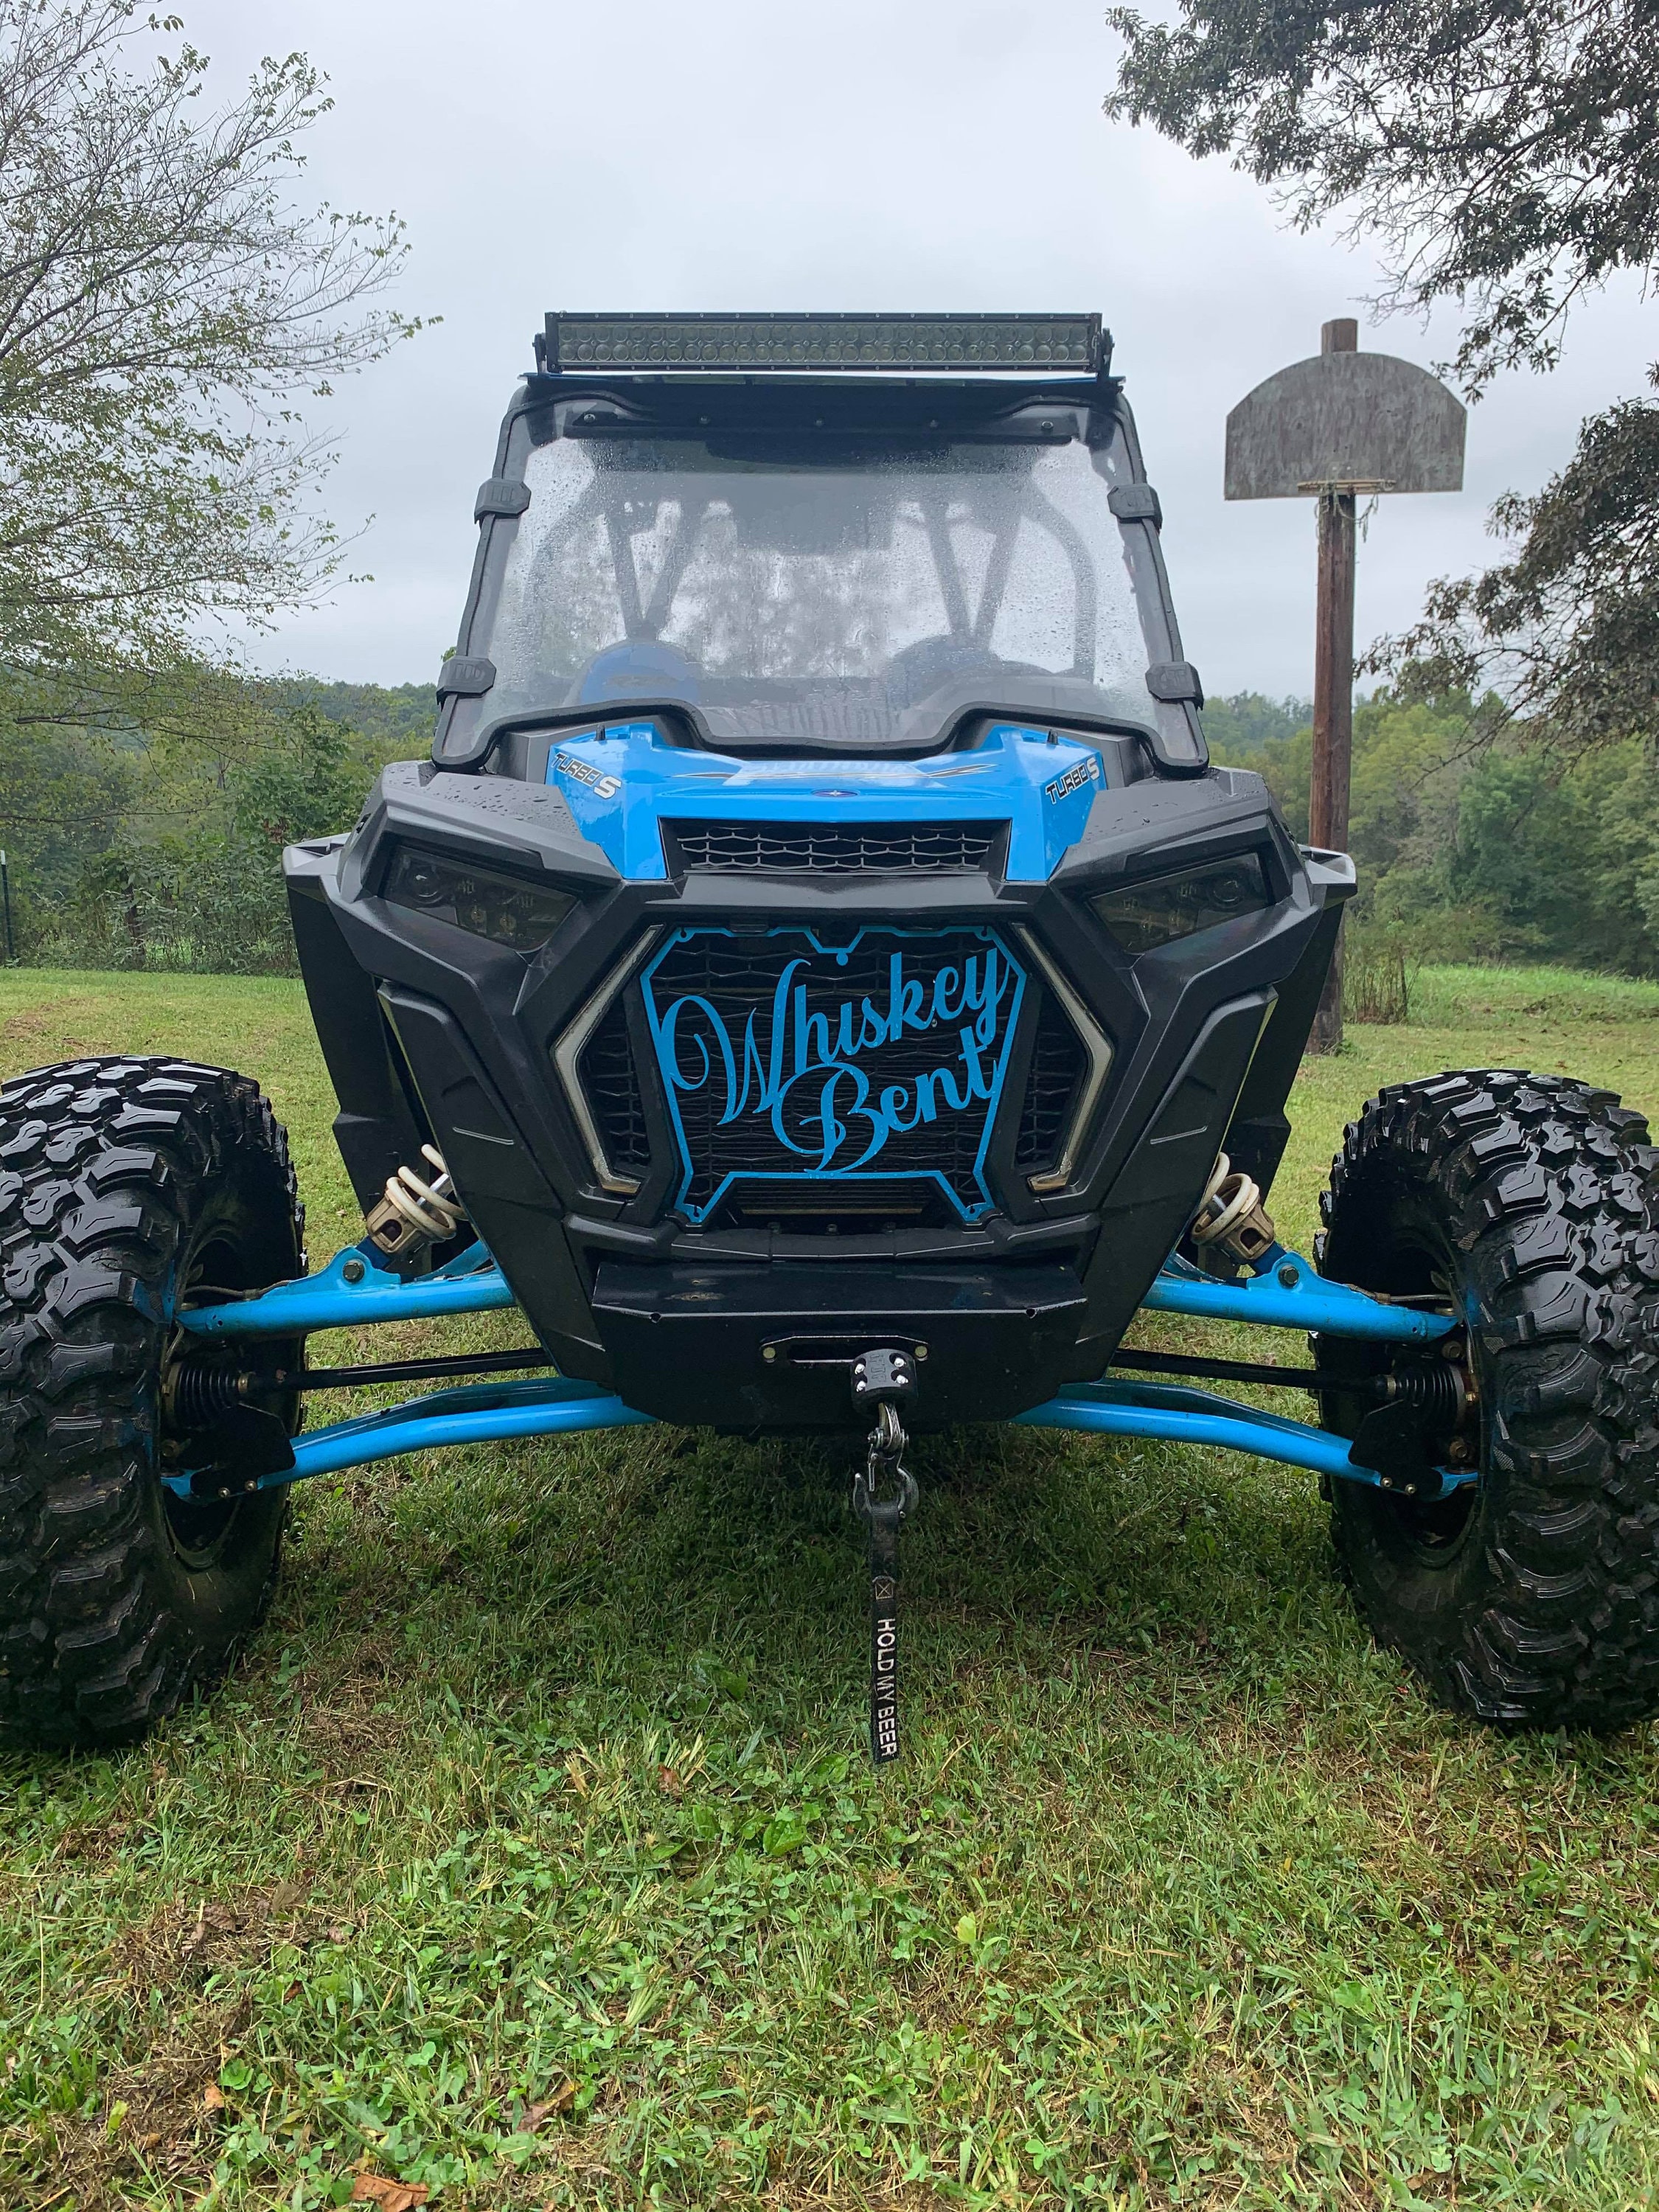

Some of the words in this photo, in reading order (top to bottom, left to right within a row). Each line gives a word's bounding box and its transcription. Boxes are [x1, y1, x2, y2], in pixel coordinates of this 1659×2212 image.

[551, 752, 604, 787] TURBO
[594, 776, 622, 799] S
[1046, 763, 1090, 804] TURBO
[1087, 757, 1100, 780] S
[661, 947, 1010, 1125] Whiskey
[771, 1026, 999, 1175] Bent
[877, 1618, 896, 1672] HOLD
[877, 1675, 894, 1702] MY
[877, 1706, 897, 1756] BEER
